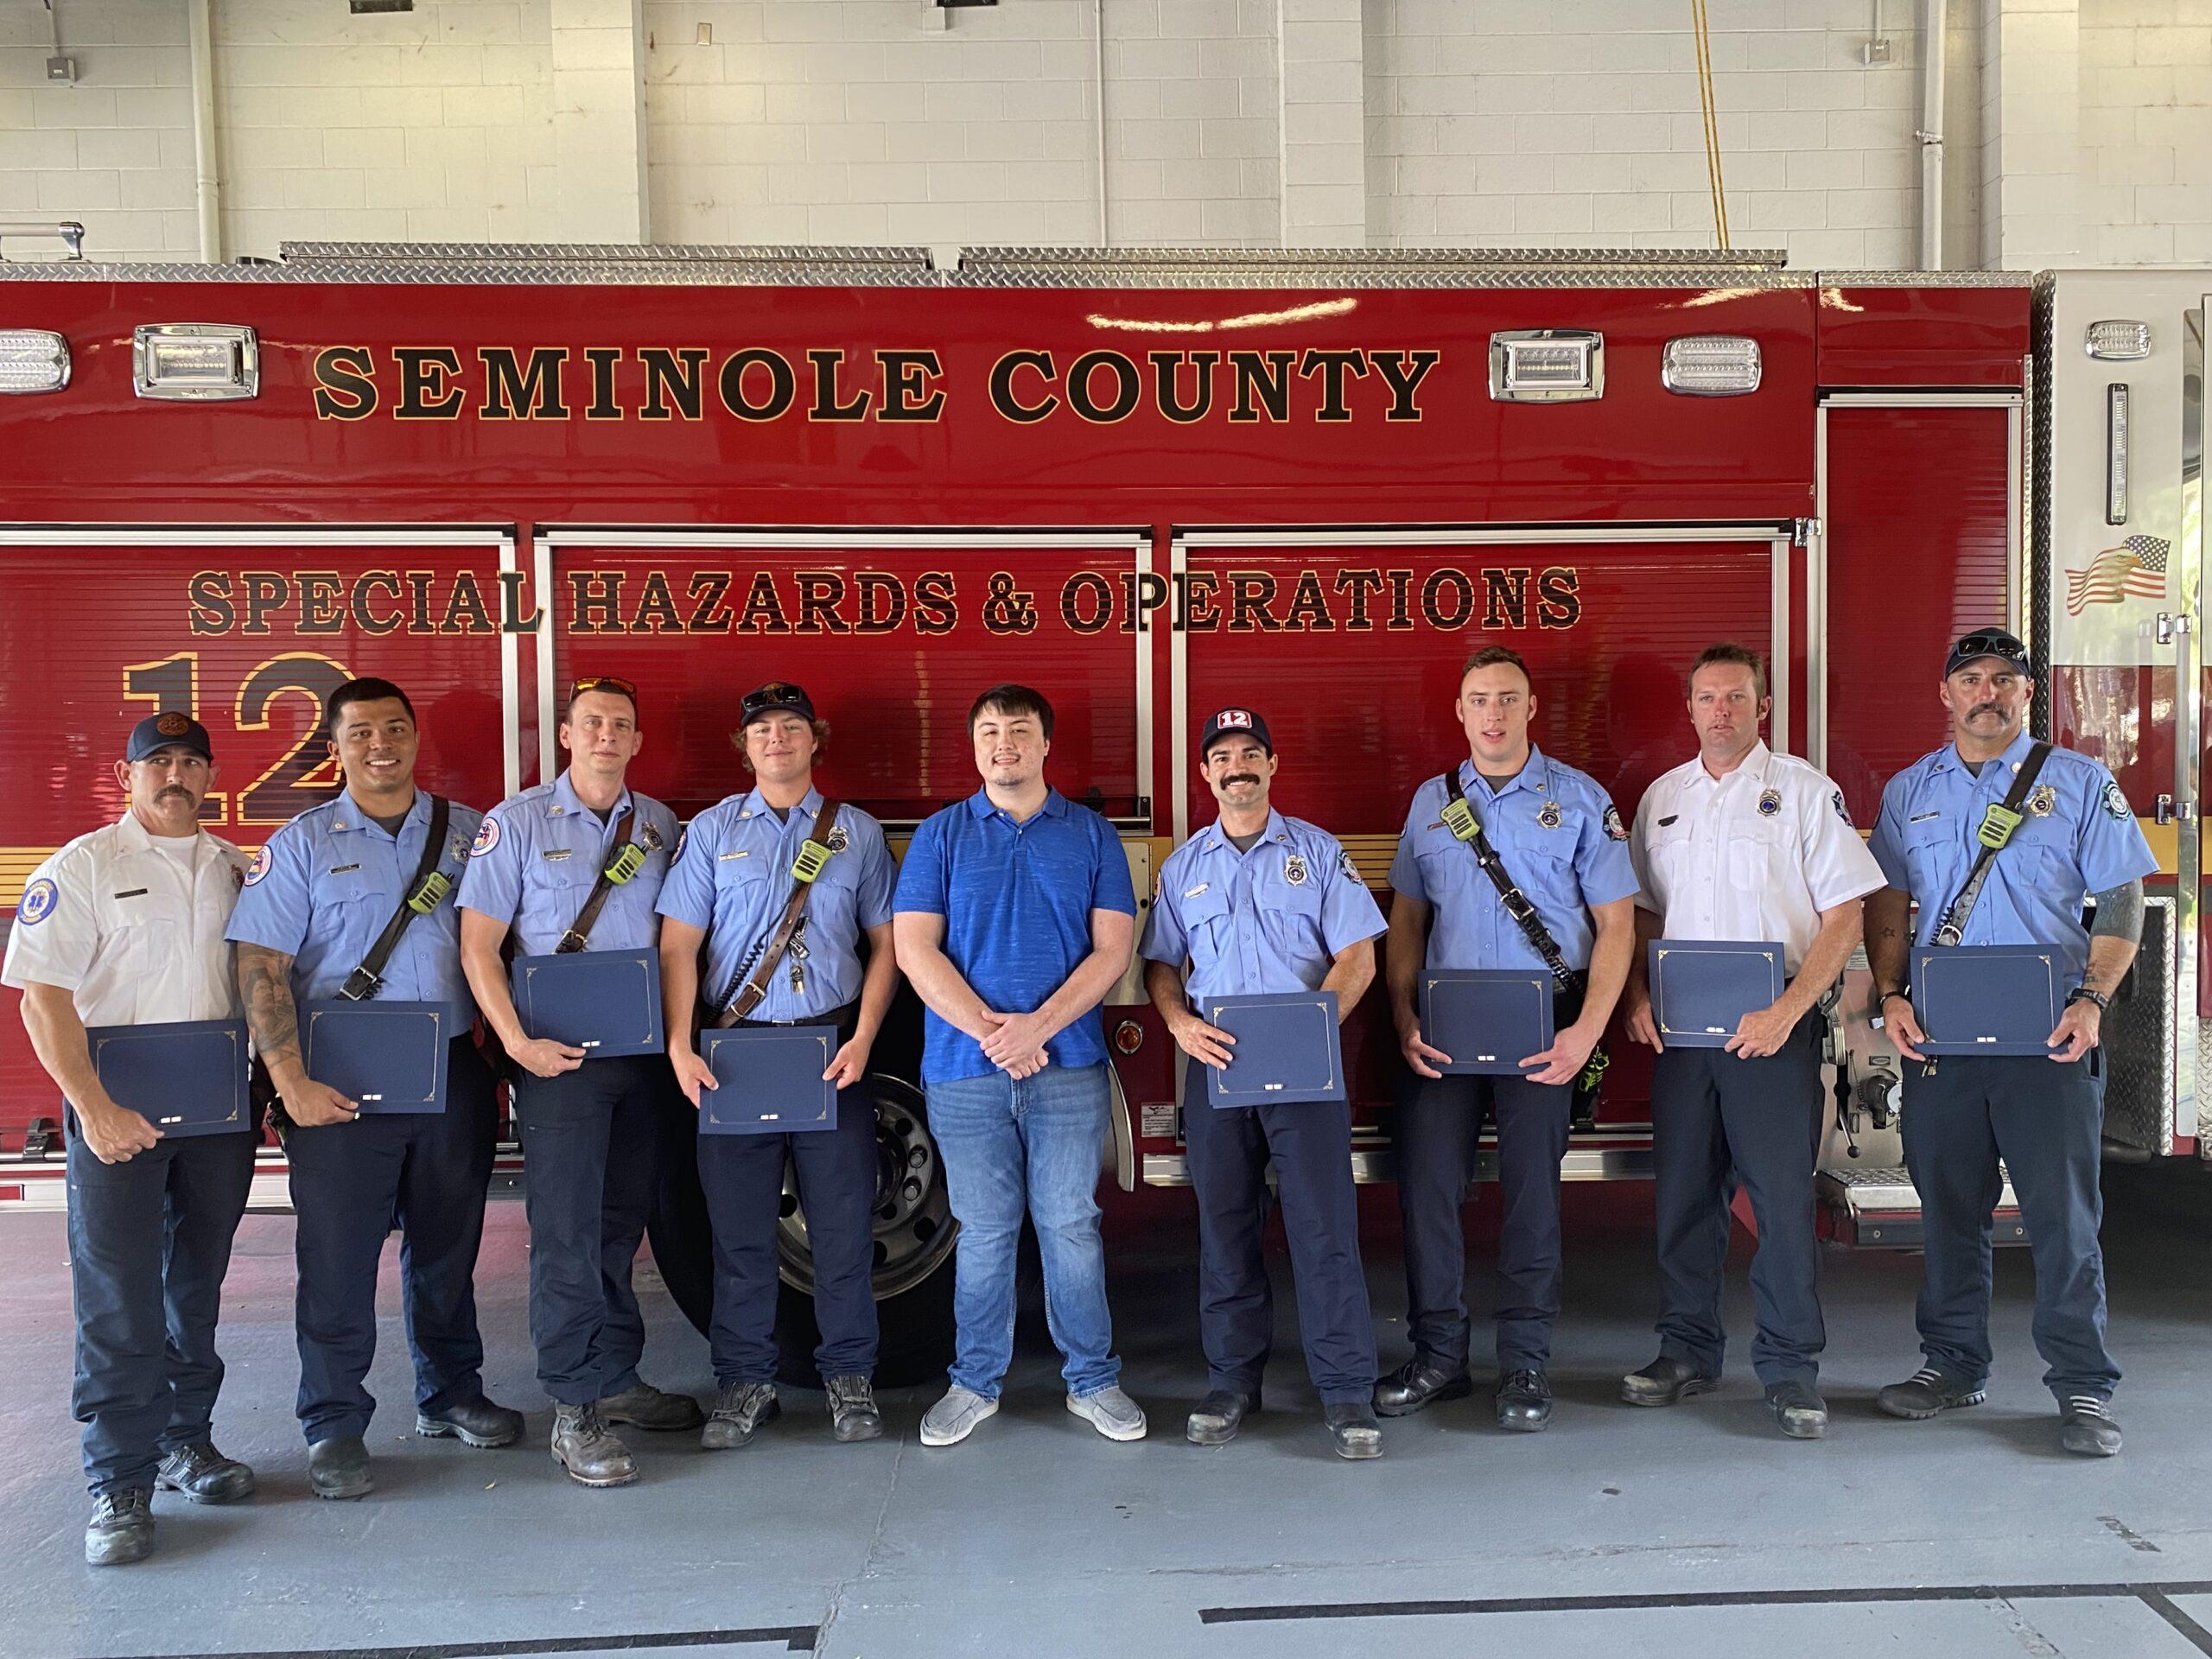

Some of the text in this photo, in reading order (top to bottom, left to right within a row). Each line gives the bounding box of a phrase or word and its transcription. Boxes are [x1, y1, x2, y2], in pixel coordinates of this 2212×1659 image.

[313, 346, 1440, 425] SEMINOLE COUNTY
[187, 567, 1582, 636] SPECIAL HAZARDS & OPERATIONS
[122, 651, 358, 827] 12
[1221, 711, 1248, 727] 12
